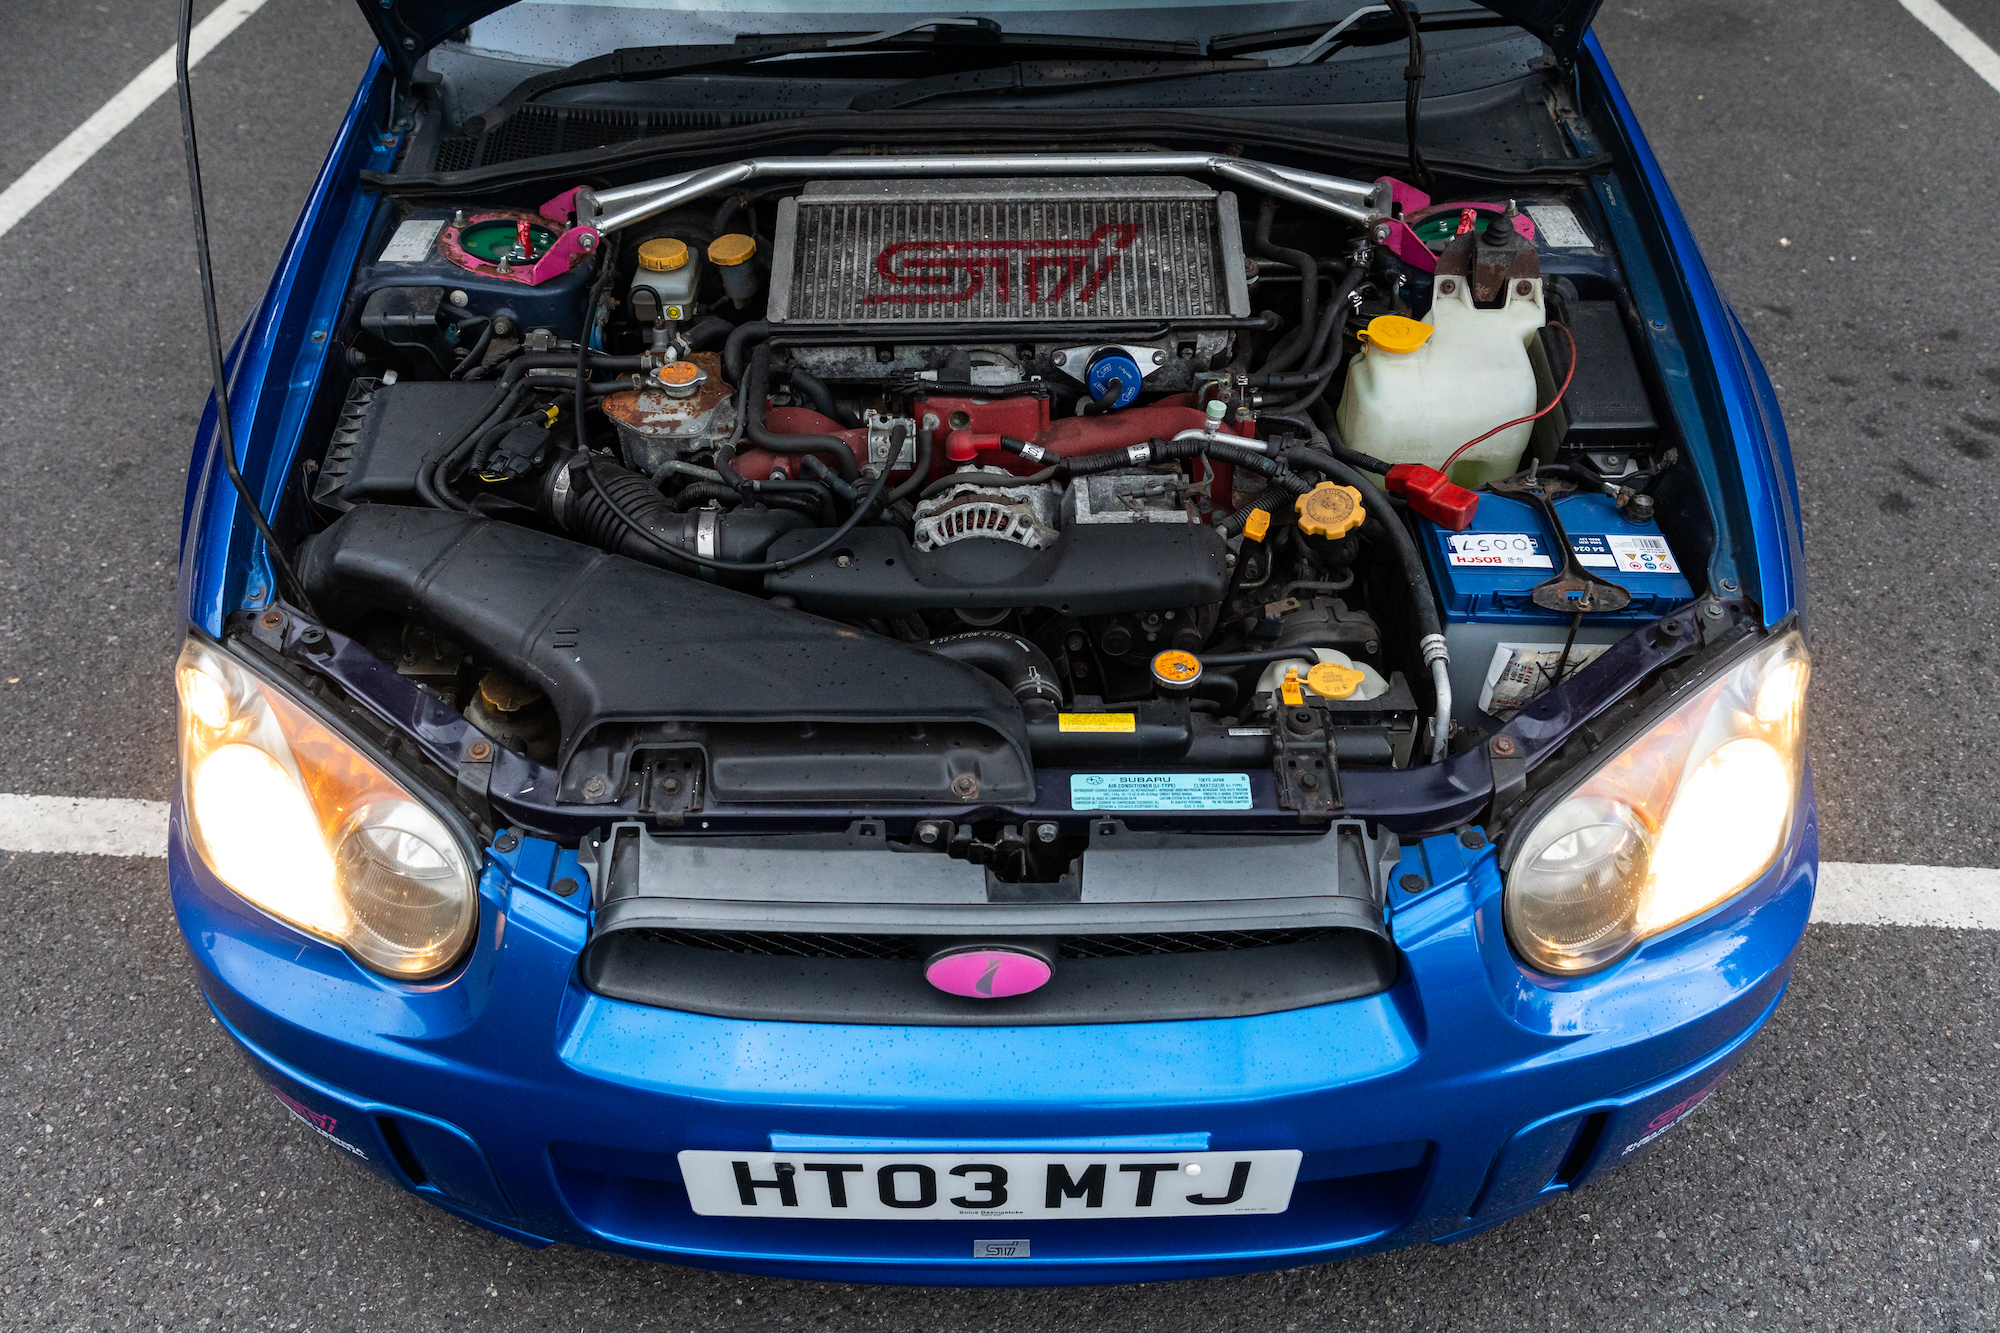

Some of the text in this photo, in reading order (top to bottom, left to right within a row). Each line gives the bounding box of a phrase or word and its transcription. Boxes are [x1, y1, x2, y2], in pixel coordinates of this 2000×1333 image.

[1457, 556, 1502, 564] BOSCH
[731, 1160, 1252, 1208] HT03 MTJ
